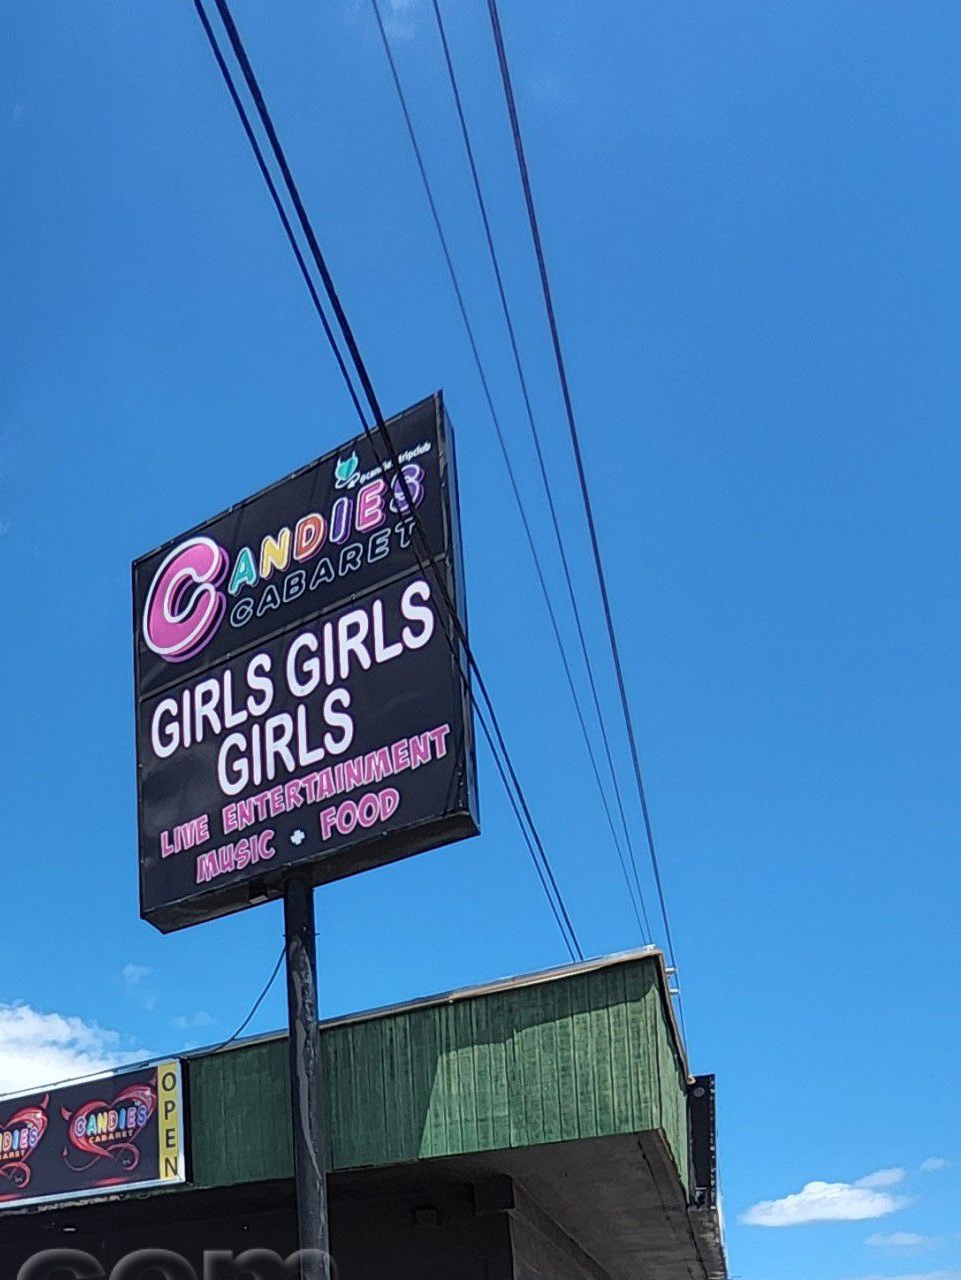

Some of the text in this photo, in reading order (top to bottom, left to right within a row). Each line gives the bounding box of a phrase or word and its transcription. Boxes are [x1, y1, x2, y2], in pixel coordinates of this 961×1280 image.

[143, 463, 426, 663] CANDIES
[229, 518, 417, 628] CABARET
[151, 581, 434, 758] GIRLS GIRLS
[159, 723, 451, 858] LIVE ENTERTAINMENT
[217, 687, 354, 796] GIRLS
[195, 787, 400, 885] MUSIC FOOD
[74, 1104, 148, 1138] CANDIES
[160, 1070, 180, 1178] OPEN
